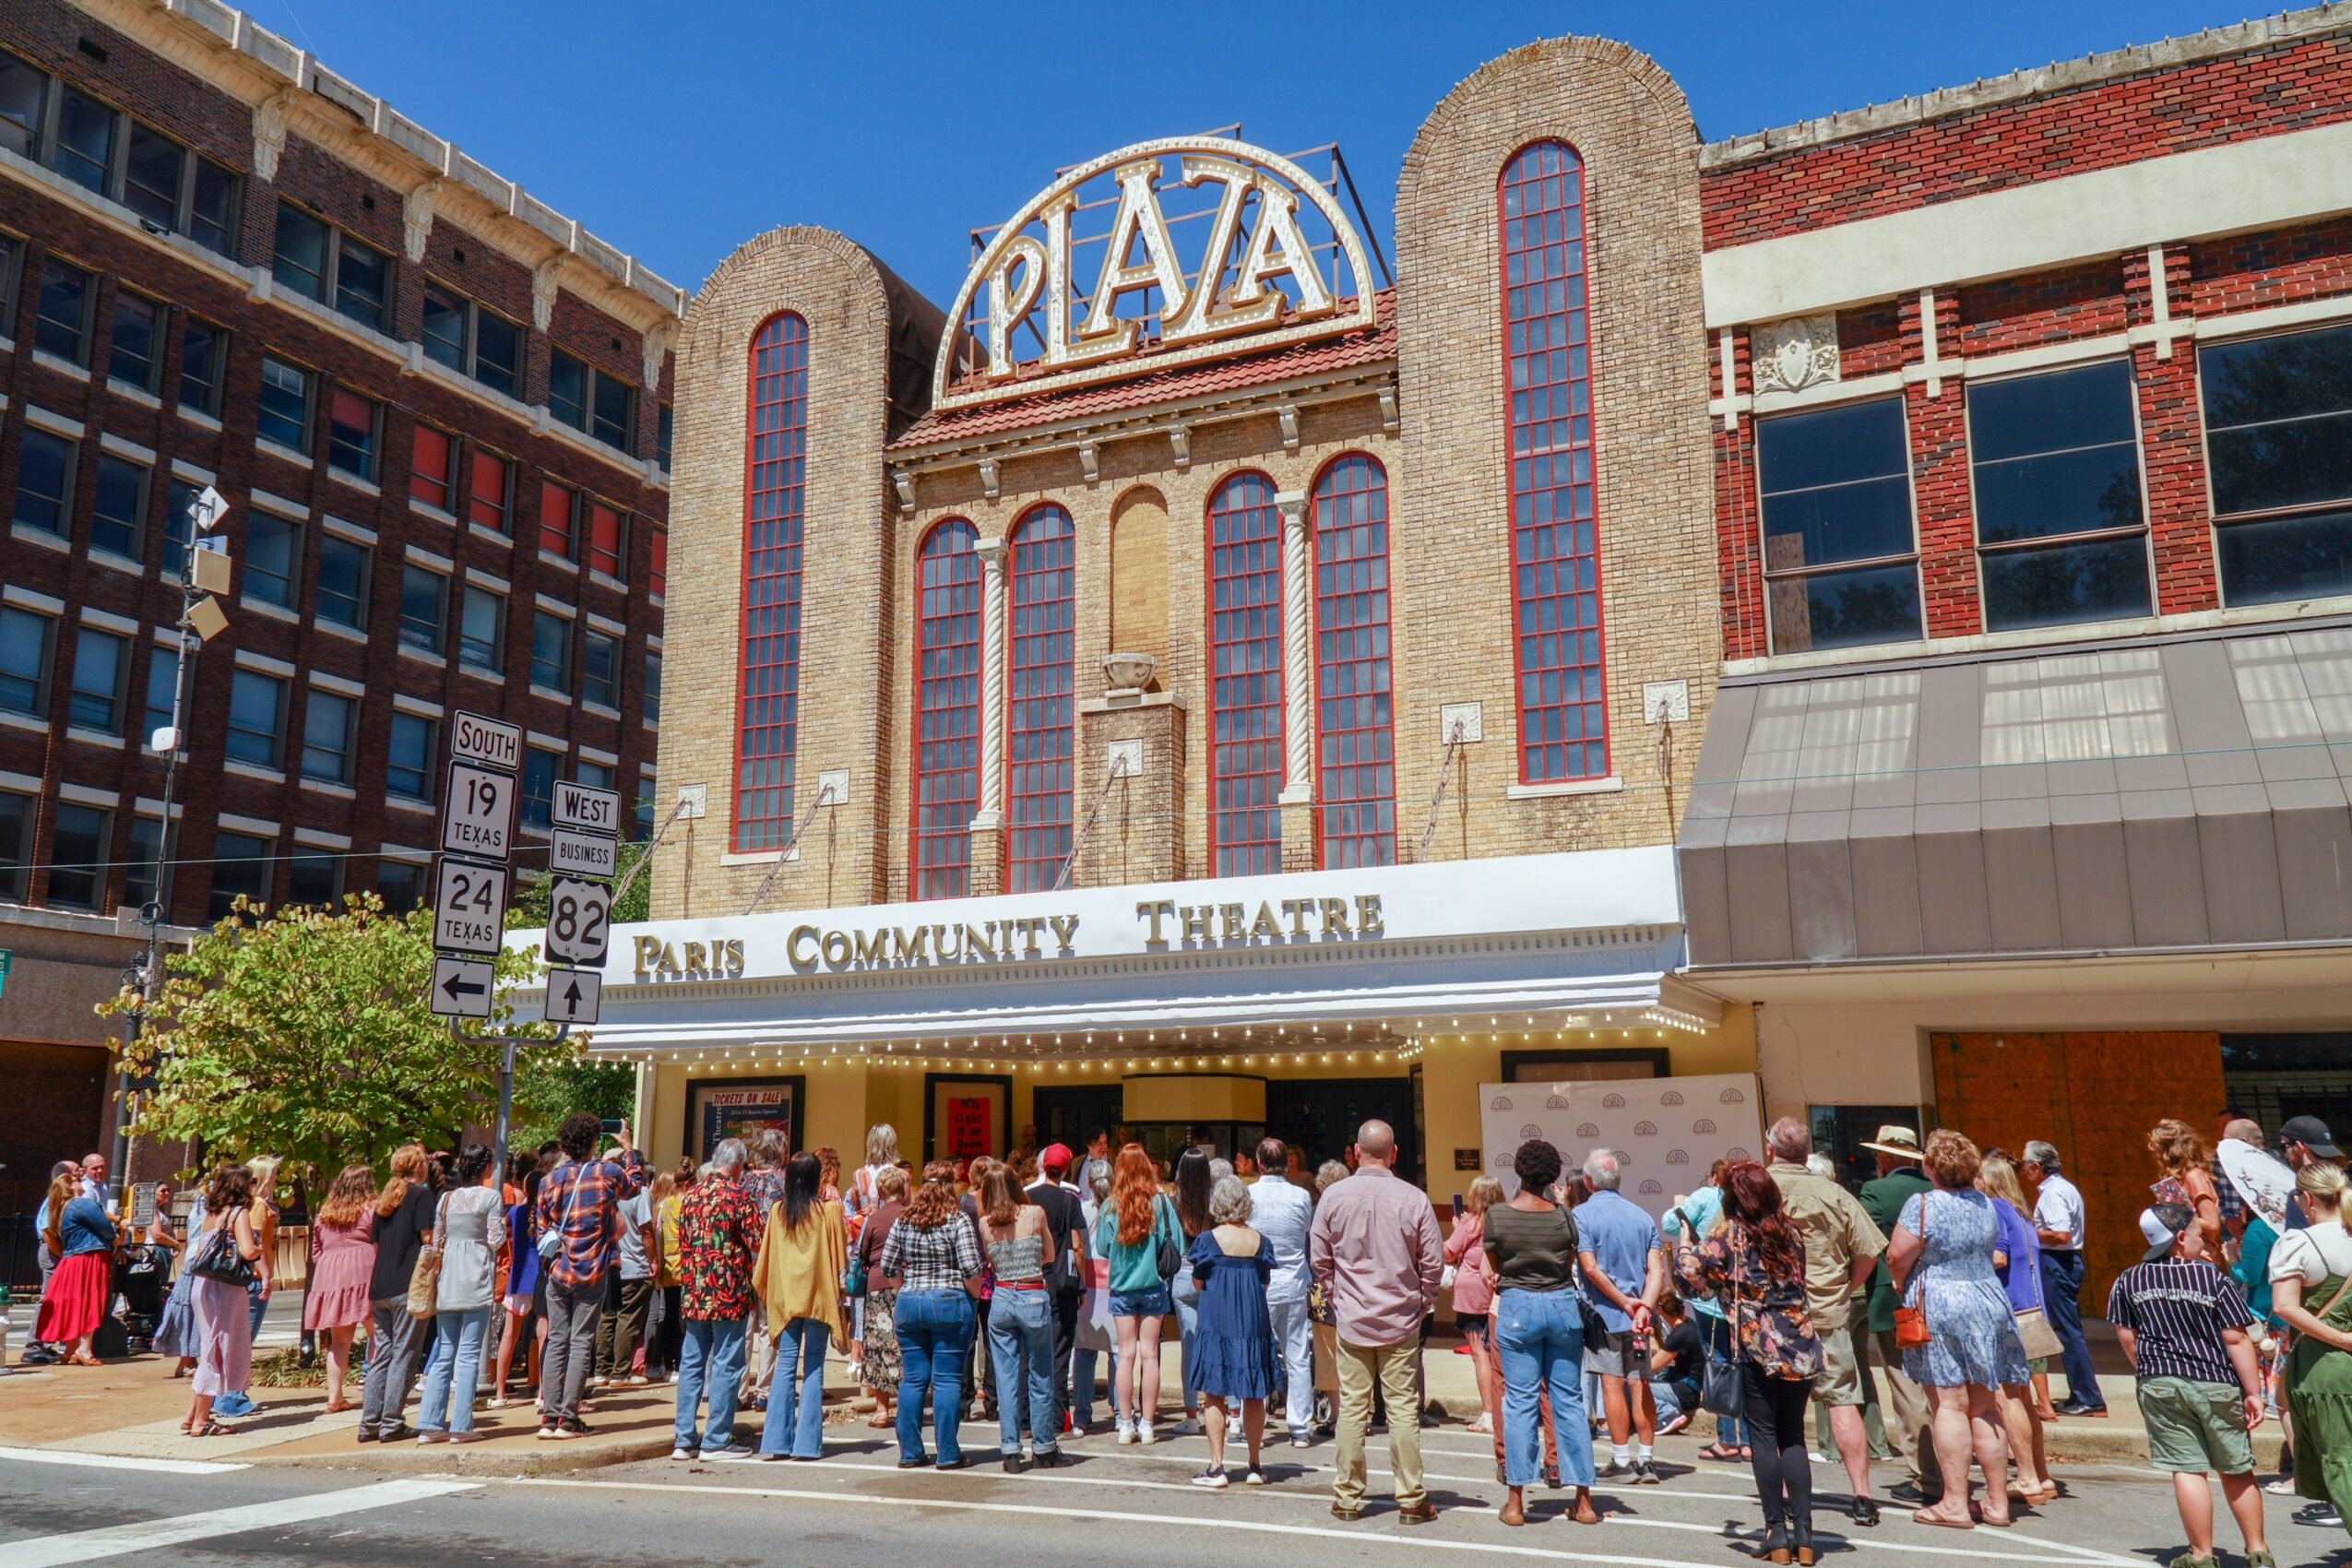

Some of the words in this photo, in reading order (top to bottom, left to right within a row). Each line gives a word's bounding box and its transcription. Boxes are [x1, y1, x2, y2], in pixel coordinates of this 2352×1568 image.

[982, 155, 1336, 383] PLAZA
[458, 720, 516, 761] SOUTH
[467, 778, 497, 817] 19
[564, 790, 611, 824] WEST
[454, 823, 502, 847] TEXAS
[560, 842, 610, 865] BUSINESS
[449, 873, 493, 915] 24
[445, 920, 493, 942] TEXAS
[554, 896, 604, 946] 82
[633, 933, 744, 976] PARIS
[786, 913, 1079, 968] COMMUNITY
[1136, 893, 1384, 945] THEATRE
[713, 1094, 743, 1104] TICKETS
[747, 1093, 758, 1103] ON
[762, 1092, 779, 1103] SALE
